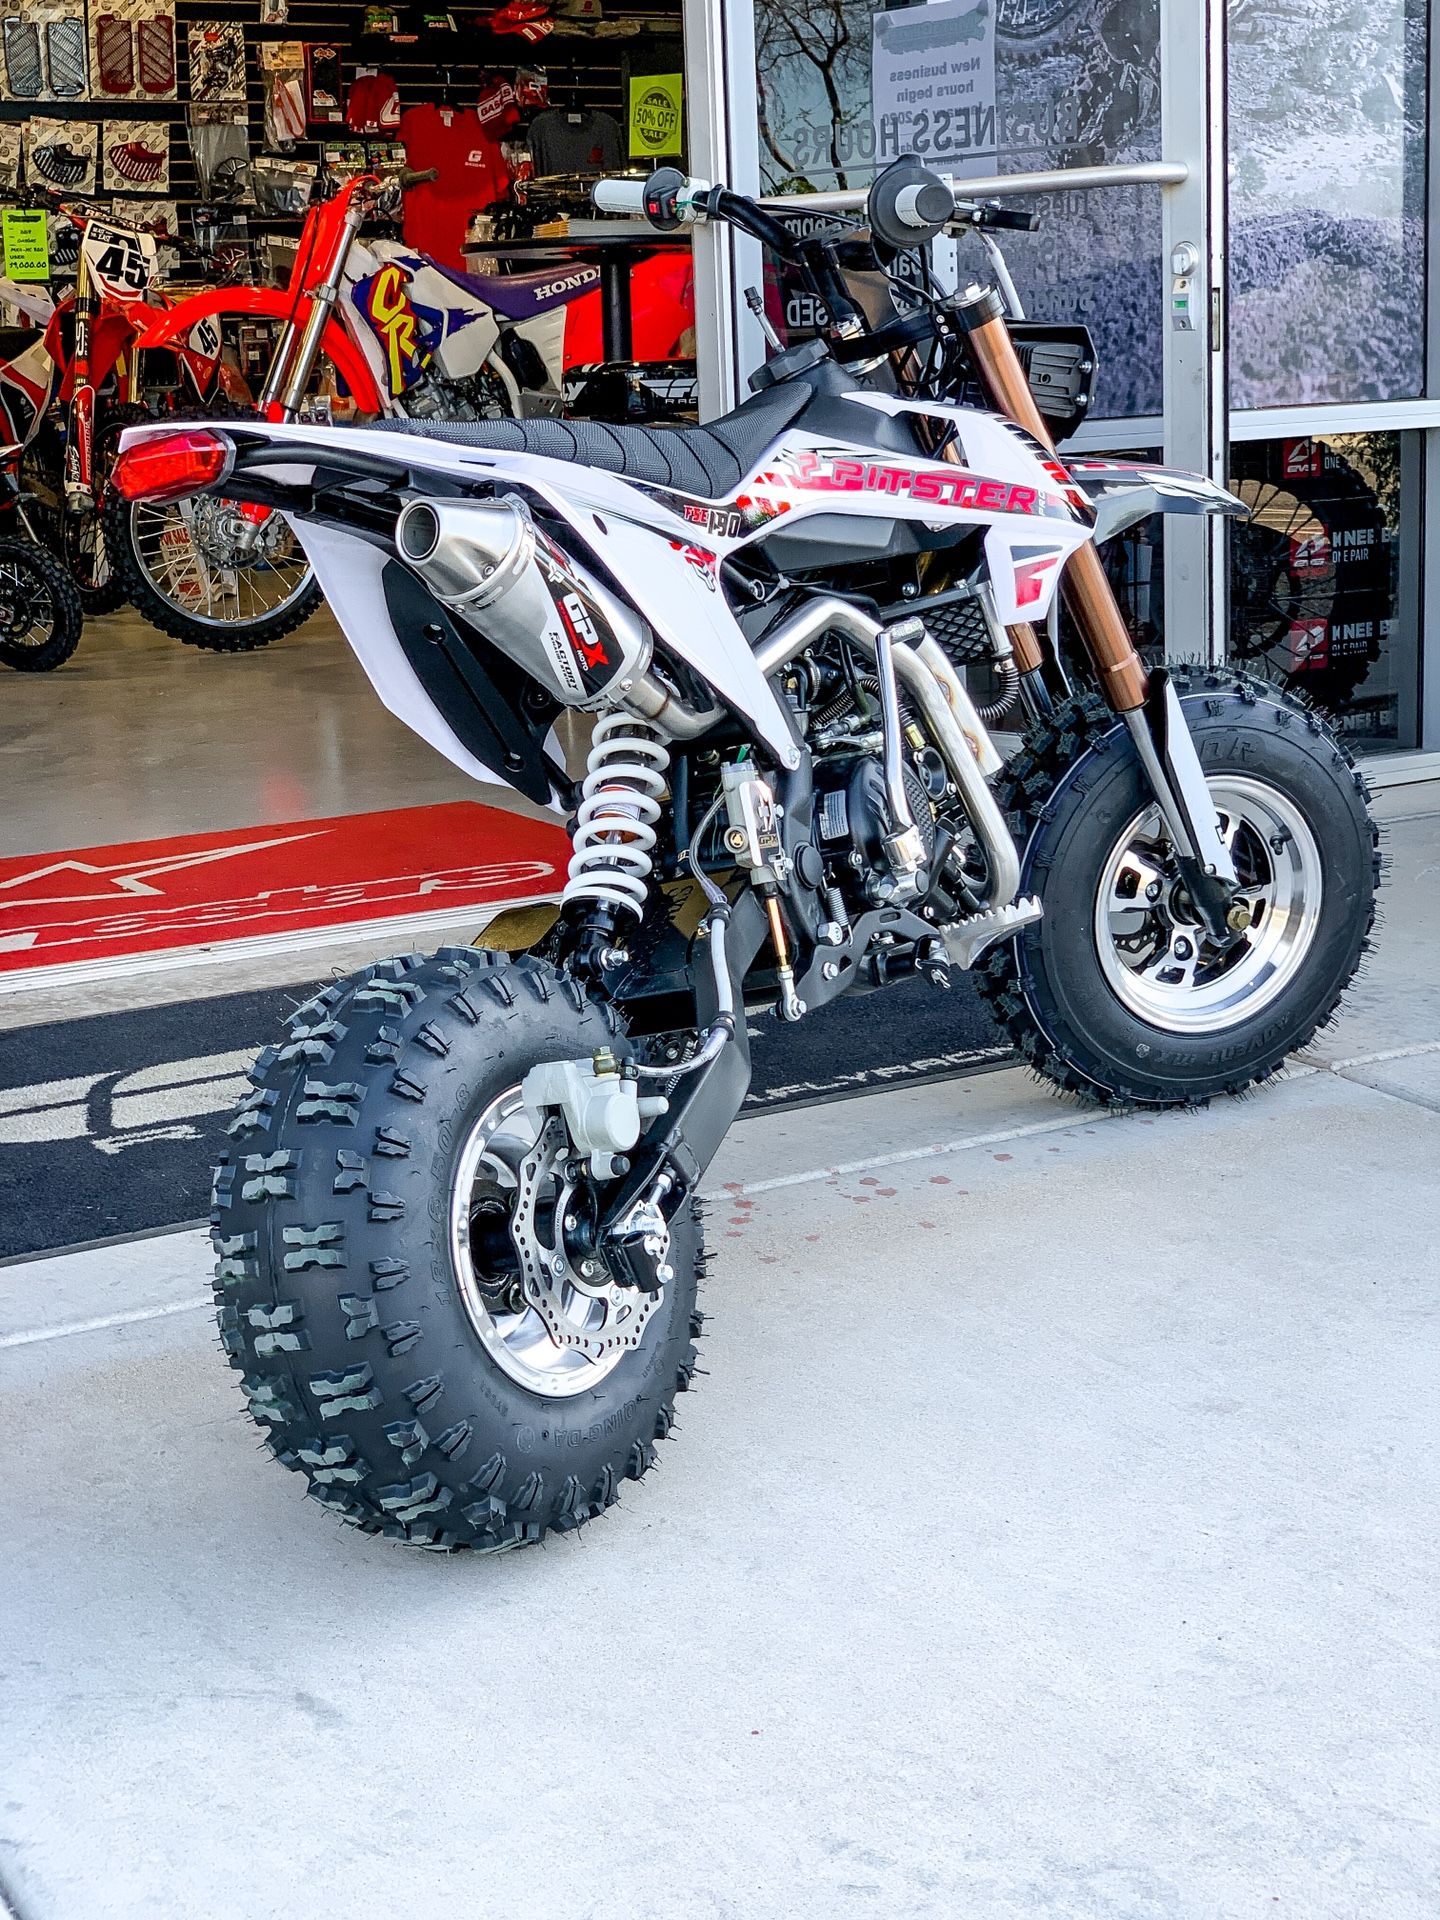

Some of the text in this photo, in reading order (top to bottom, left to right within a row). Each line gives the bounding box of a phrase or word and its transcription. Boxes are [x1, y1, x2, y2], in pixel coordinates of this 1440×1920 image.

[657, 111, 676, 129] OFF
[96, 246, 151, 289] 45
[831, 459, 1038, 515] PITSTER
[551, 631, 579, 691] FACTORY
[576, 649, 589, 672] MOTO
